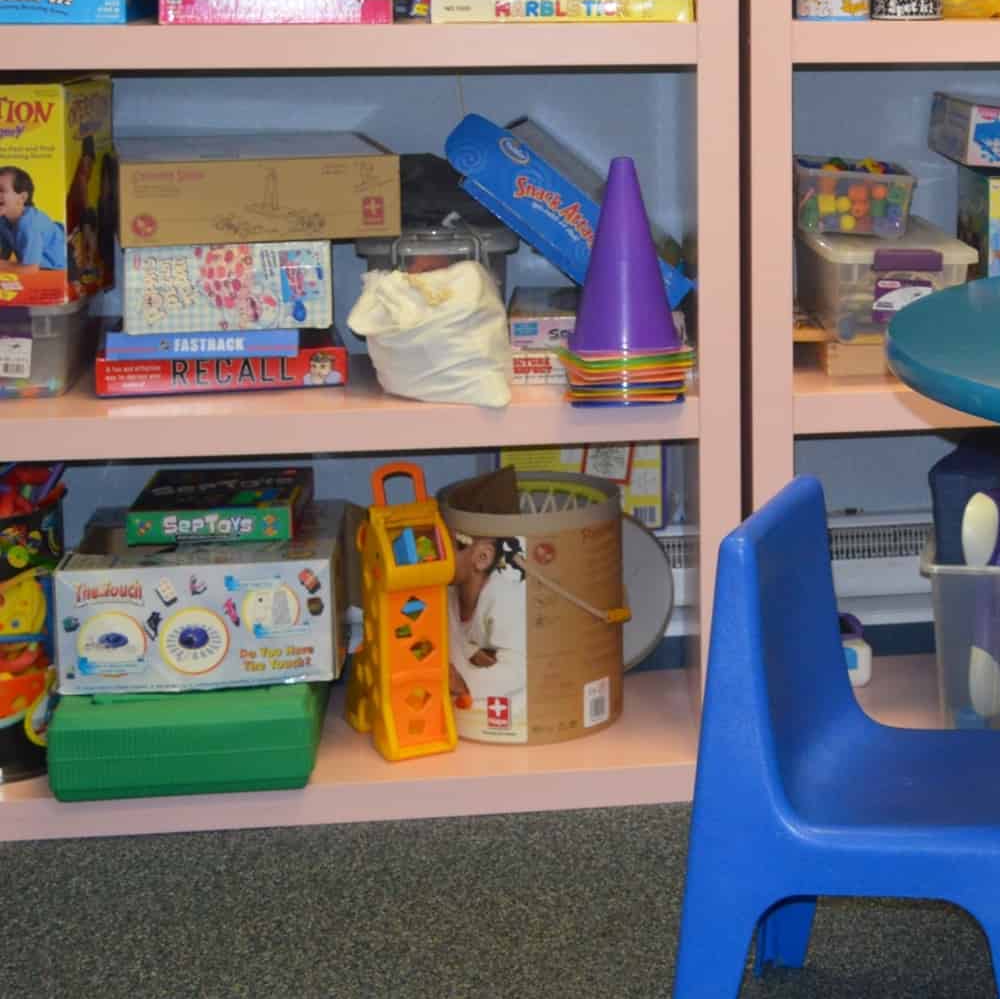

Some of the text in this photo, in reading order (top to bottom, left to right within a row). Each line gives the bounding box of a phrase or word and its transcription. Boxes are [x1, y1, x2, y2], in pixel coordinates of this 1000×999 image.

[514, 176, 561, 212] Snack
[174, 338, 245, 352] FASTRACK
[171, 356, 296, 386] RECALL
